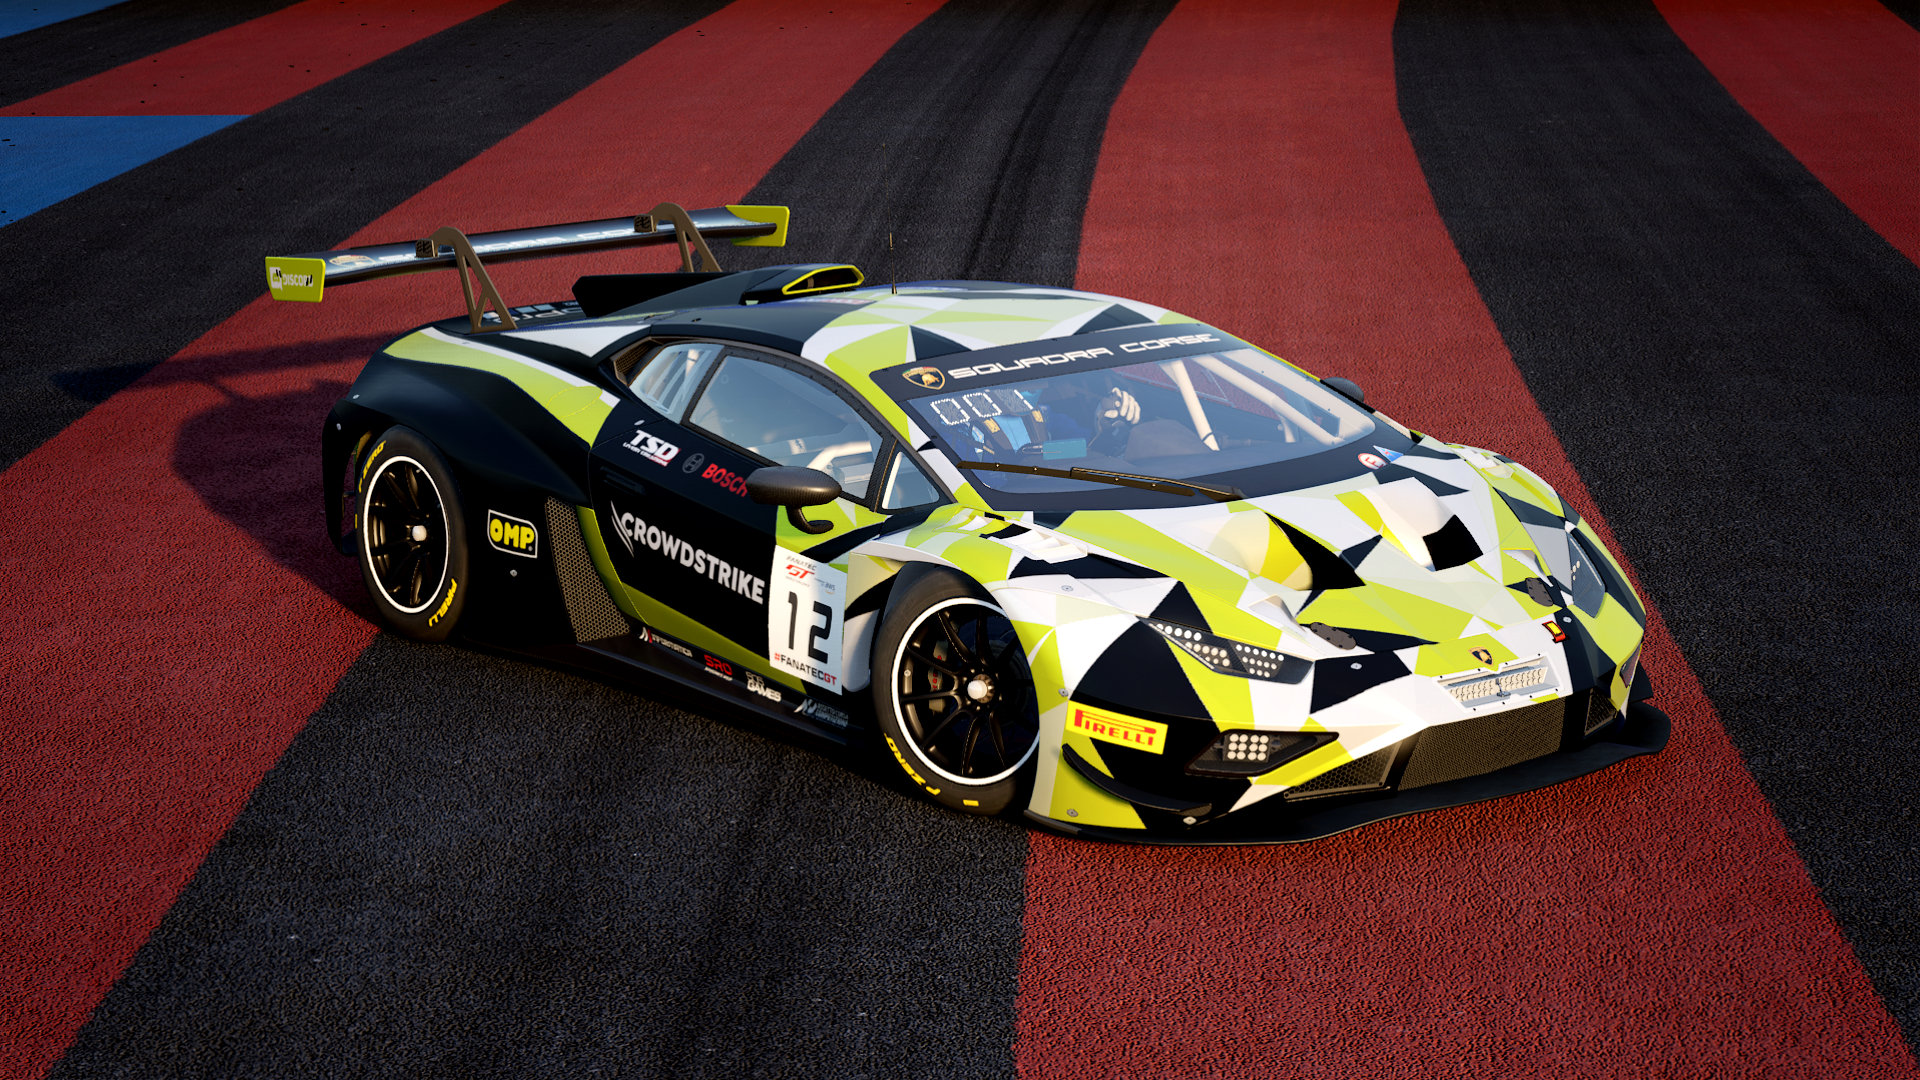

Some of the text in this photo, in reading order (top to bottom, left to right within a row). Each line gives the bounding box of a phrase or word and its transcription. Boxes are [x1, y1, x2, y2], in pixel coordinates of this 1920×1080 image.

[947, 346, 1114, 380] SQUADRA
[1119, 332, 1221, 354] CORSE
[363, 439, 387, 479] ZERO
[630, 429, 681, 462] TSD
[490, 518, 535, 550] OMP
[621, 512, 765, 605] CROWDSTRIKE
[785, 555, 818, 571] FANATEC
[428, 577, 458, 627] PIRELLI
[787, 590, 833, 664] 12
[703, 653, 734, 676] SRO
[774, 652, 837, 686] #FANATECGT
[747, 679, 782, 703] GAMES
[1074, 708, 1157, 746] PIRELLI
[883, 732, 927, 786] ZERO
